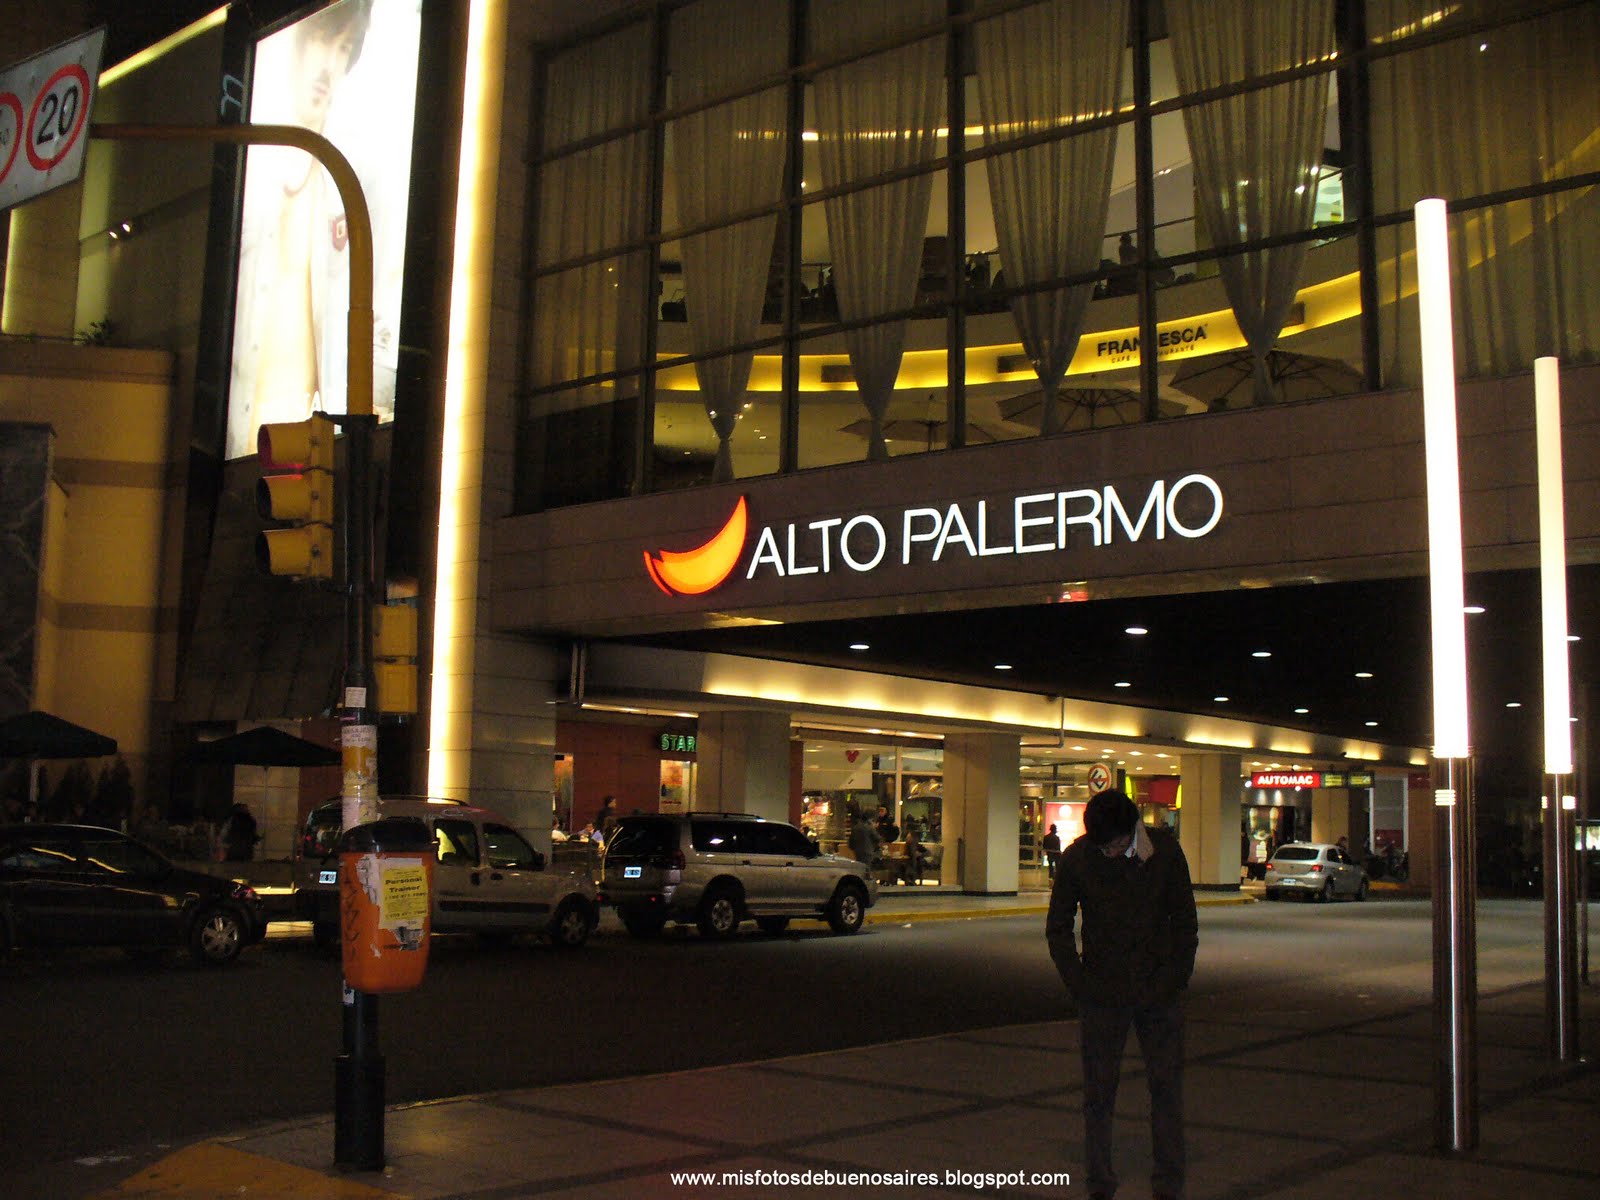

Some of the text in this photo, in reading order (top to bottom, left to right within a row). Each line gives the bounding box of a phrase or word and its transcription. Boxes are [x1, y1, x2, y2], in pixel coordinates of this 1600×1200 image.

[37, 85, 79, 145] 20
[1097, 325, 1208, 356] FRANESCA
[746, 473, 1224, 580] ALTO PALERMO
[661, 733, 696, 752] STAR
[1257, 775, 1314, 786] AUTOMAC
